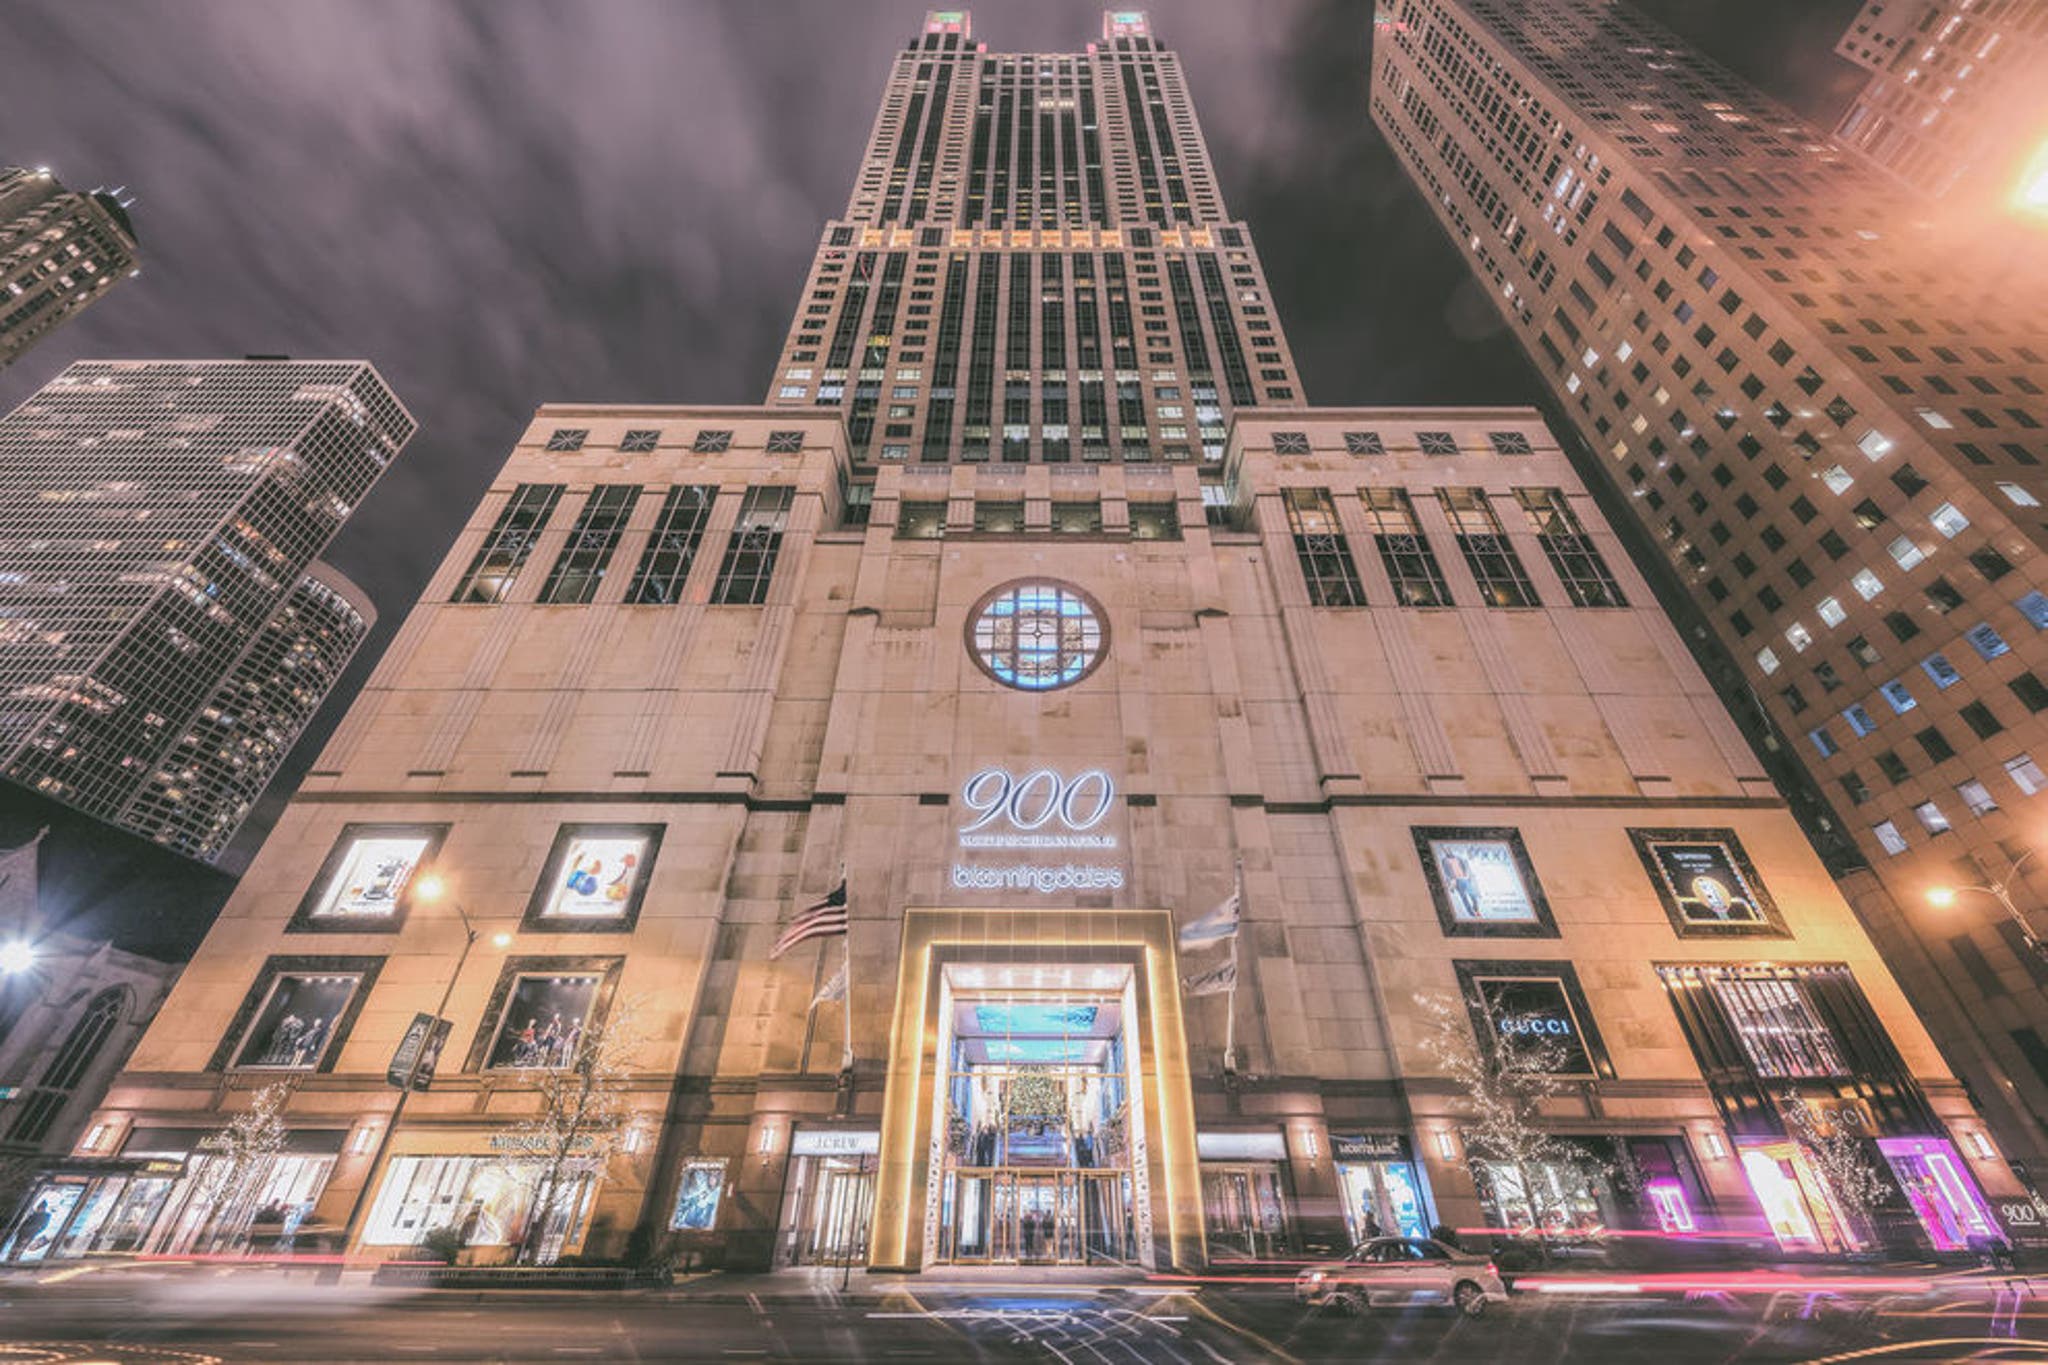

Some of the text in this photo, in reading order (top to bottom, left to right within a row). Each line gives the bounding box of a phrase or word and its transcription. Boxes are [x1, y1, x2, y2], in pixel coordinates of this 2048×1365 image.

[958, 767, 1115, 833] 900
[1500, 1018, 1571, 1035] GUCCI
[2002, 1204, 2035, 1223] 900
